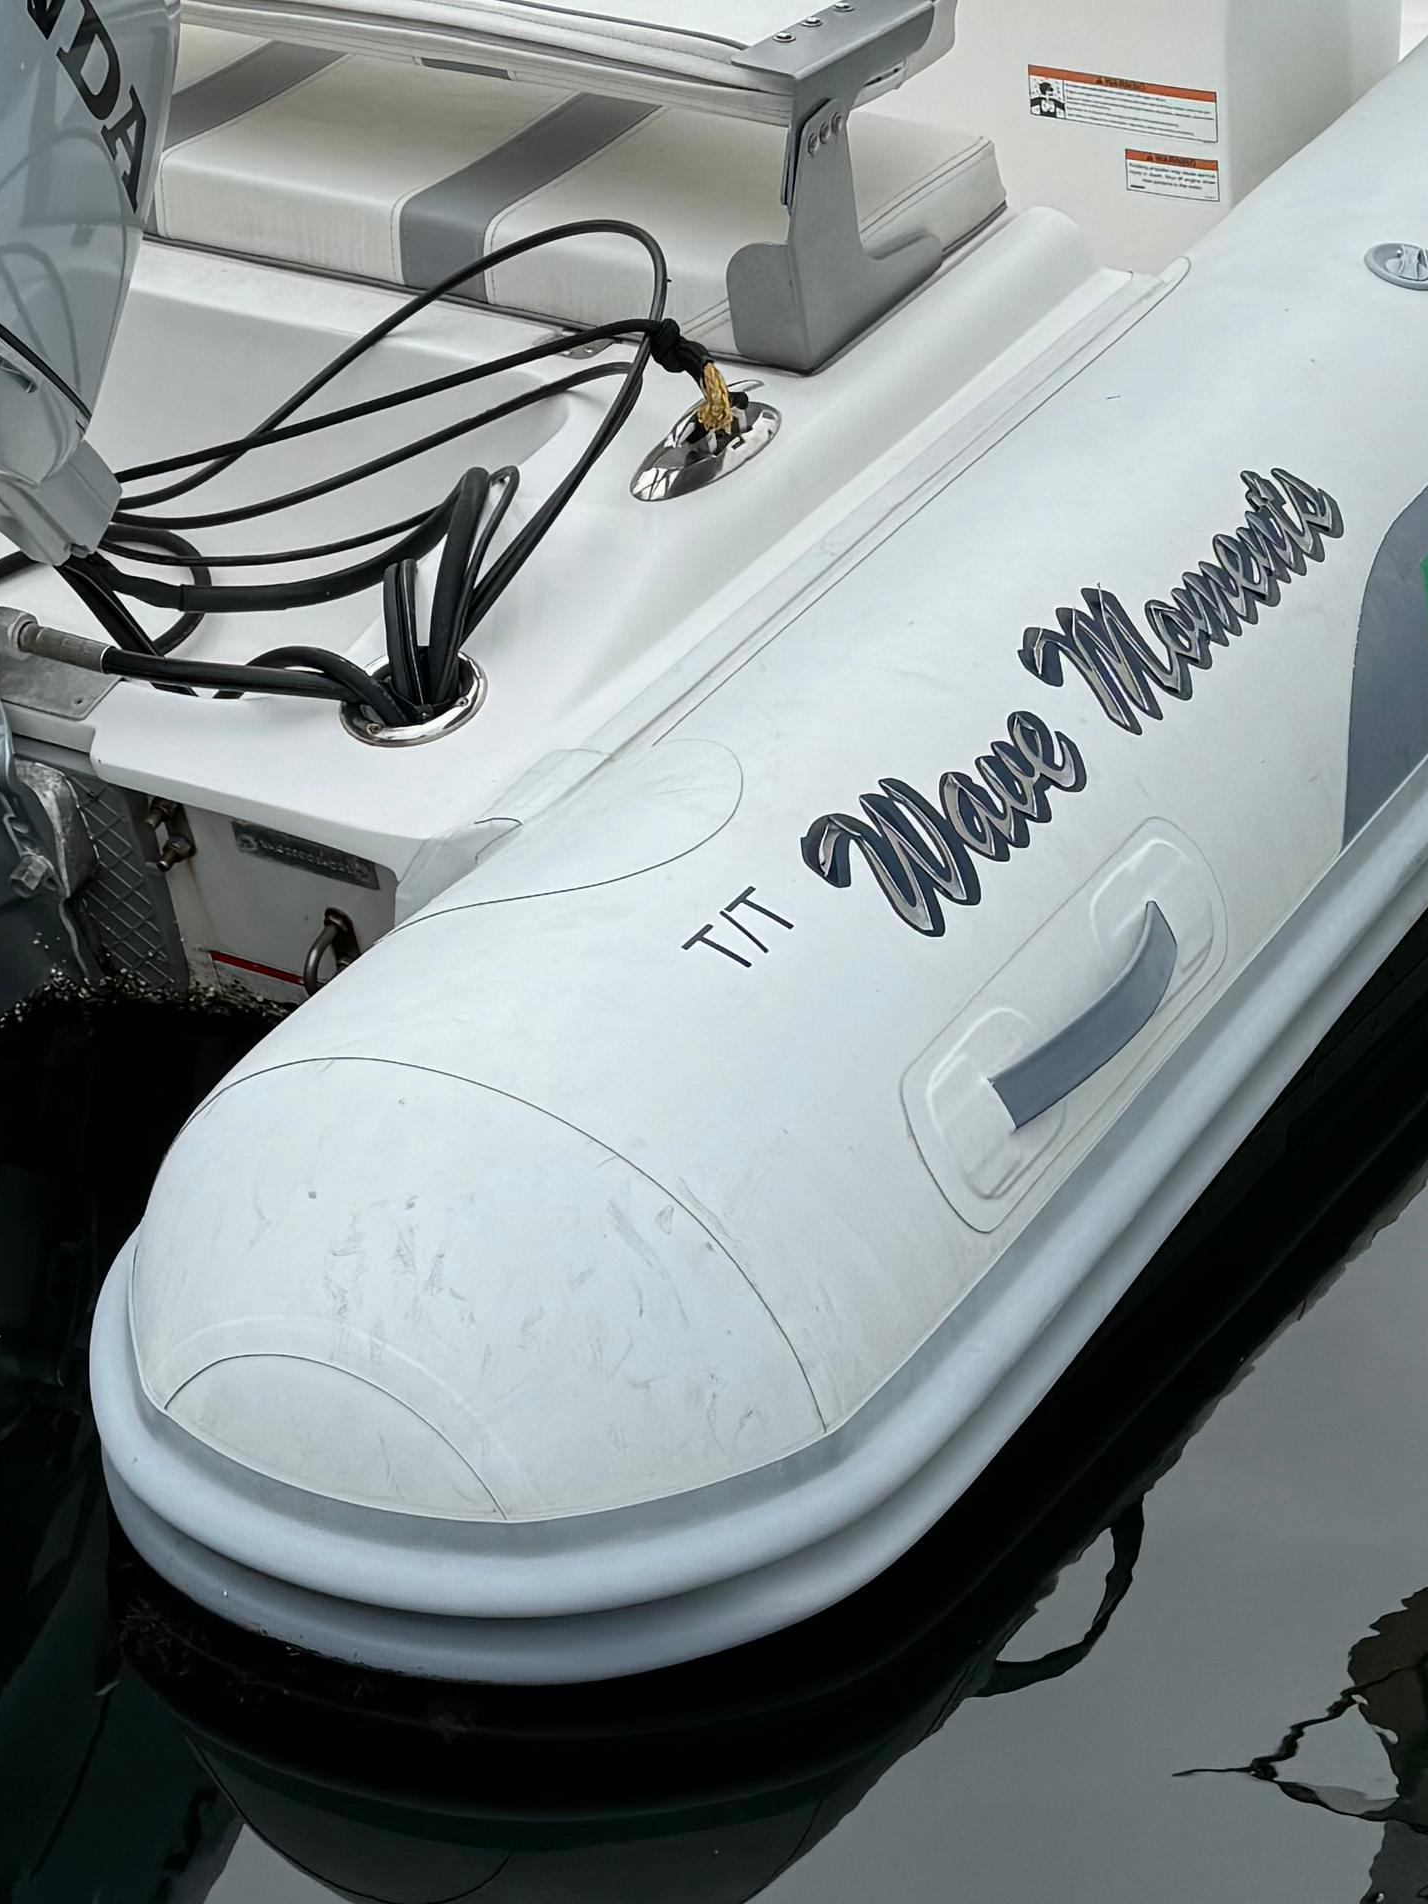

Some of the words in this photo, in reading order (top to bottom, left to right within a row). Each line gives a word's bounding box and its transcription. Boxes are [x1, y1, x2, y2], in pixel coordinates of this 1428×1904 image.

[801, 710, 1086, 937] Wave
[1017, 467, 1344, 735] Moments
[681, 885, 794, 968] T/T
